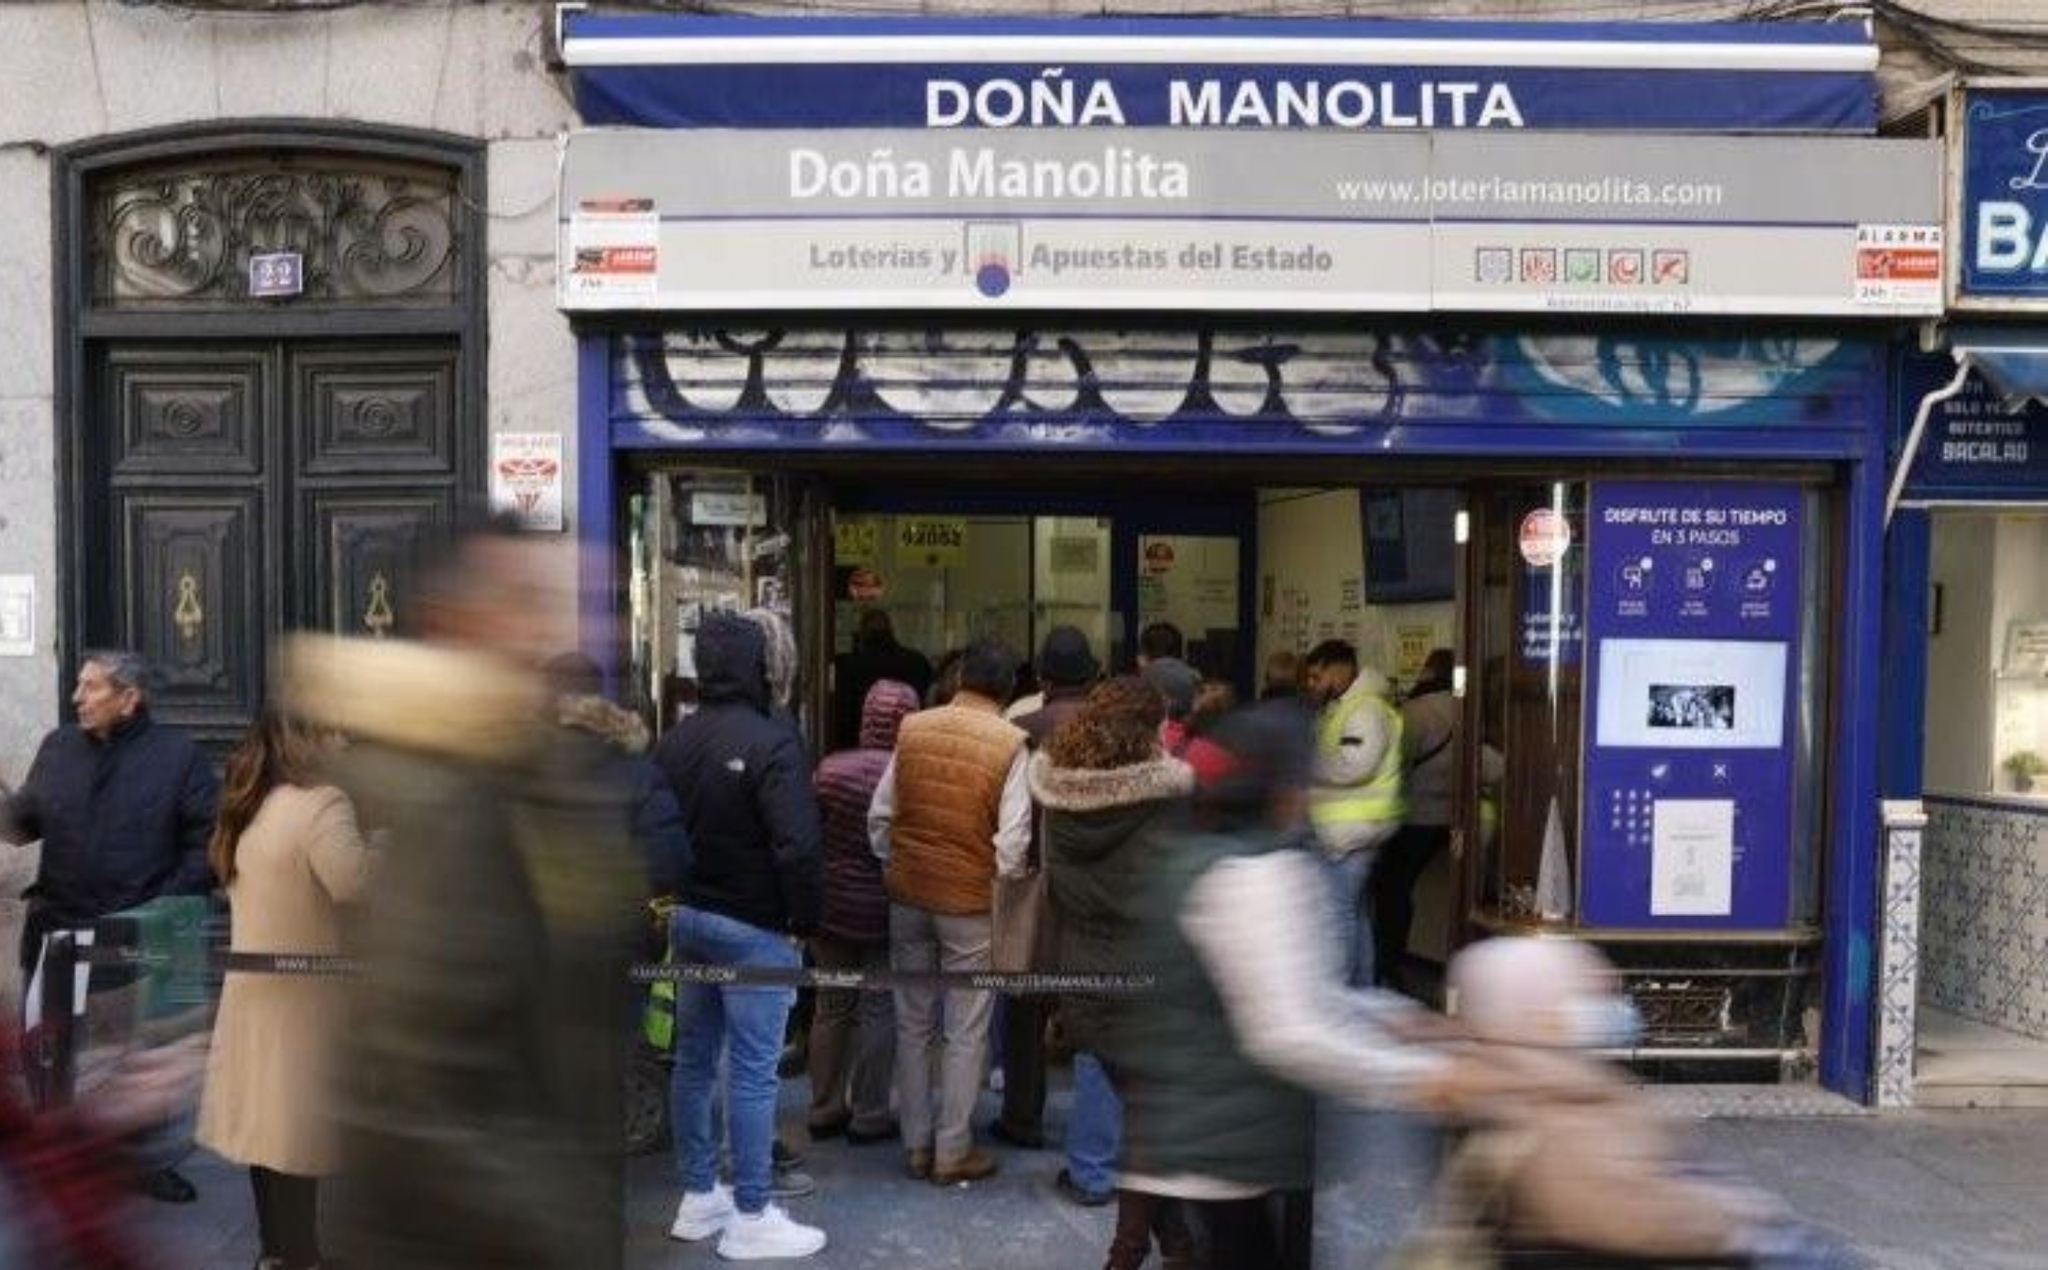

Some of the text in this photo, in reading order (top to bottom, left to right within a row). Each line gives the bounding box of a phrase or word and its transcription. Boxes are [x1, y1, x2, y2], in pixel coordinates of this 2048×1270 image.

[926, 68, 1525, 127] DOÑA MANOLITA
[789, 147, 1189, 198] Doña Manolita
[1335, 175, 1723, 206] www.loteriamanolita.com
[941, 250, 958, 275] y
[1030, 243, 1168, 275] Apuestas
[1178, 243, 1222, 269] del
[1232, 244, 1333, 271] Estado
[1942, 441, 2028, 461] BACALAO
[1604, 507, 1788, 526] DISFRUTE DE SU TIEMPO
[1651, 529, 1740, 546] EN 3 PASOS
